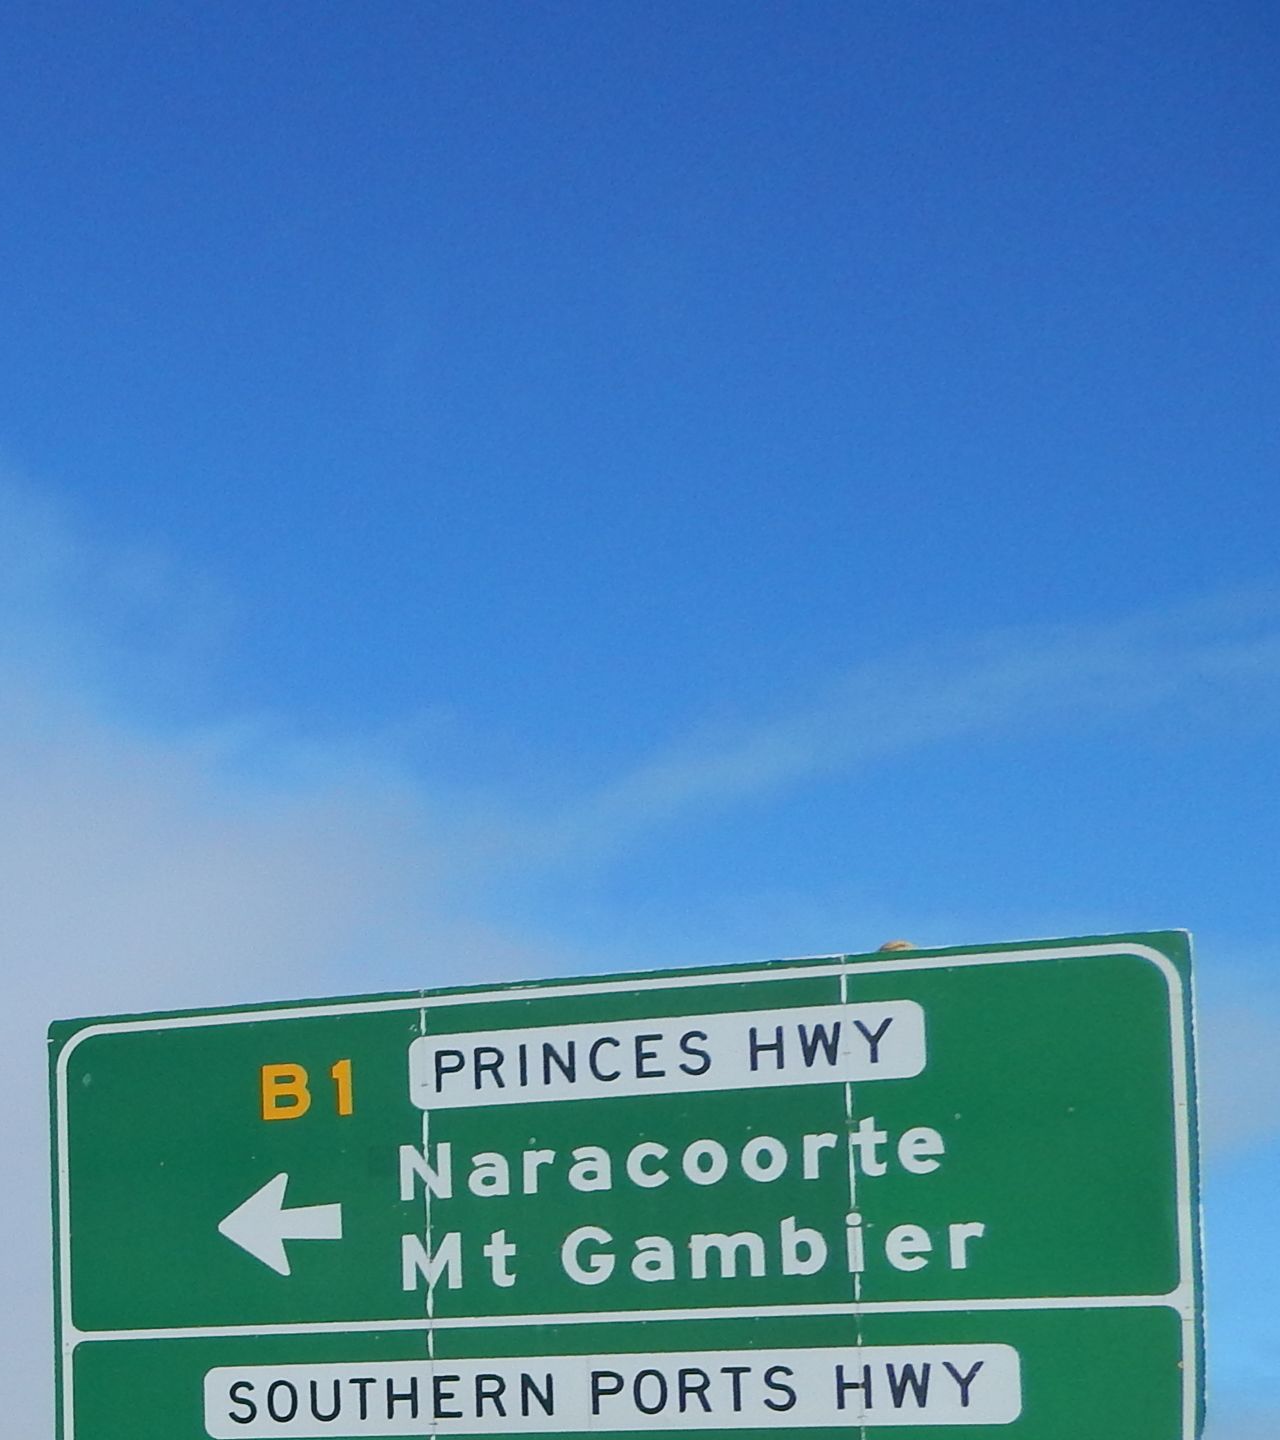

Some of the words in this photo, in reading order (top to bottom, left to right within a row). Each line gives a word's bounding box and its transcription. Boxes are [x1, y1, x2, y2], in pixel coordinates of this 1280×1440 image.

[262, 1060, 353, 1120] B1
[435, 1031, 710, 1093] PRINCES
[750, 1018, 893, 1072] HWY
[400, 1117, 945, 1201] Naracoorte
[402, 1229, 517, 1292] Mt
[561, 1213, 985, 1286] Gambier
[228, 1374, 554, 1425] SOUTHERN
[591, 1366, 797, 1416] PORTS
[836, 1361, 984, 1410] HWY
